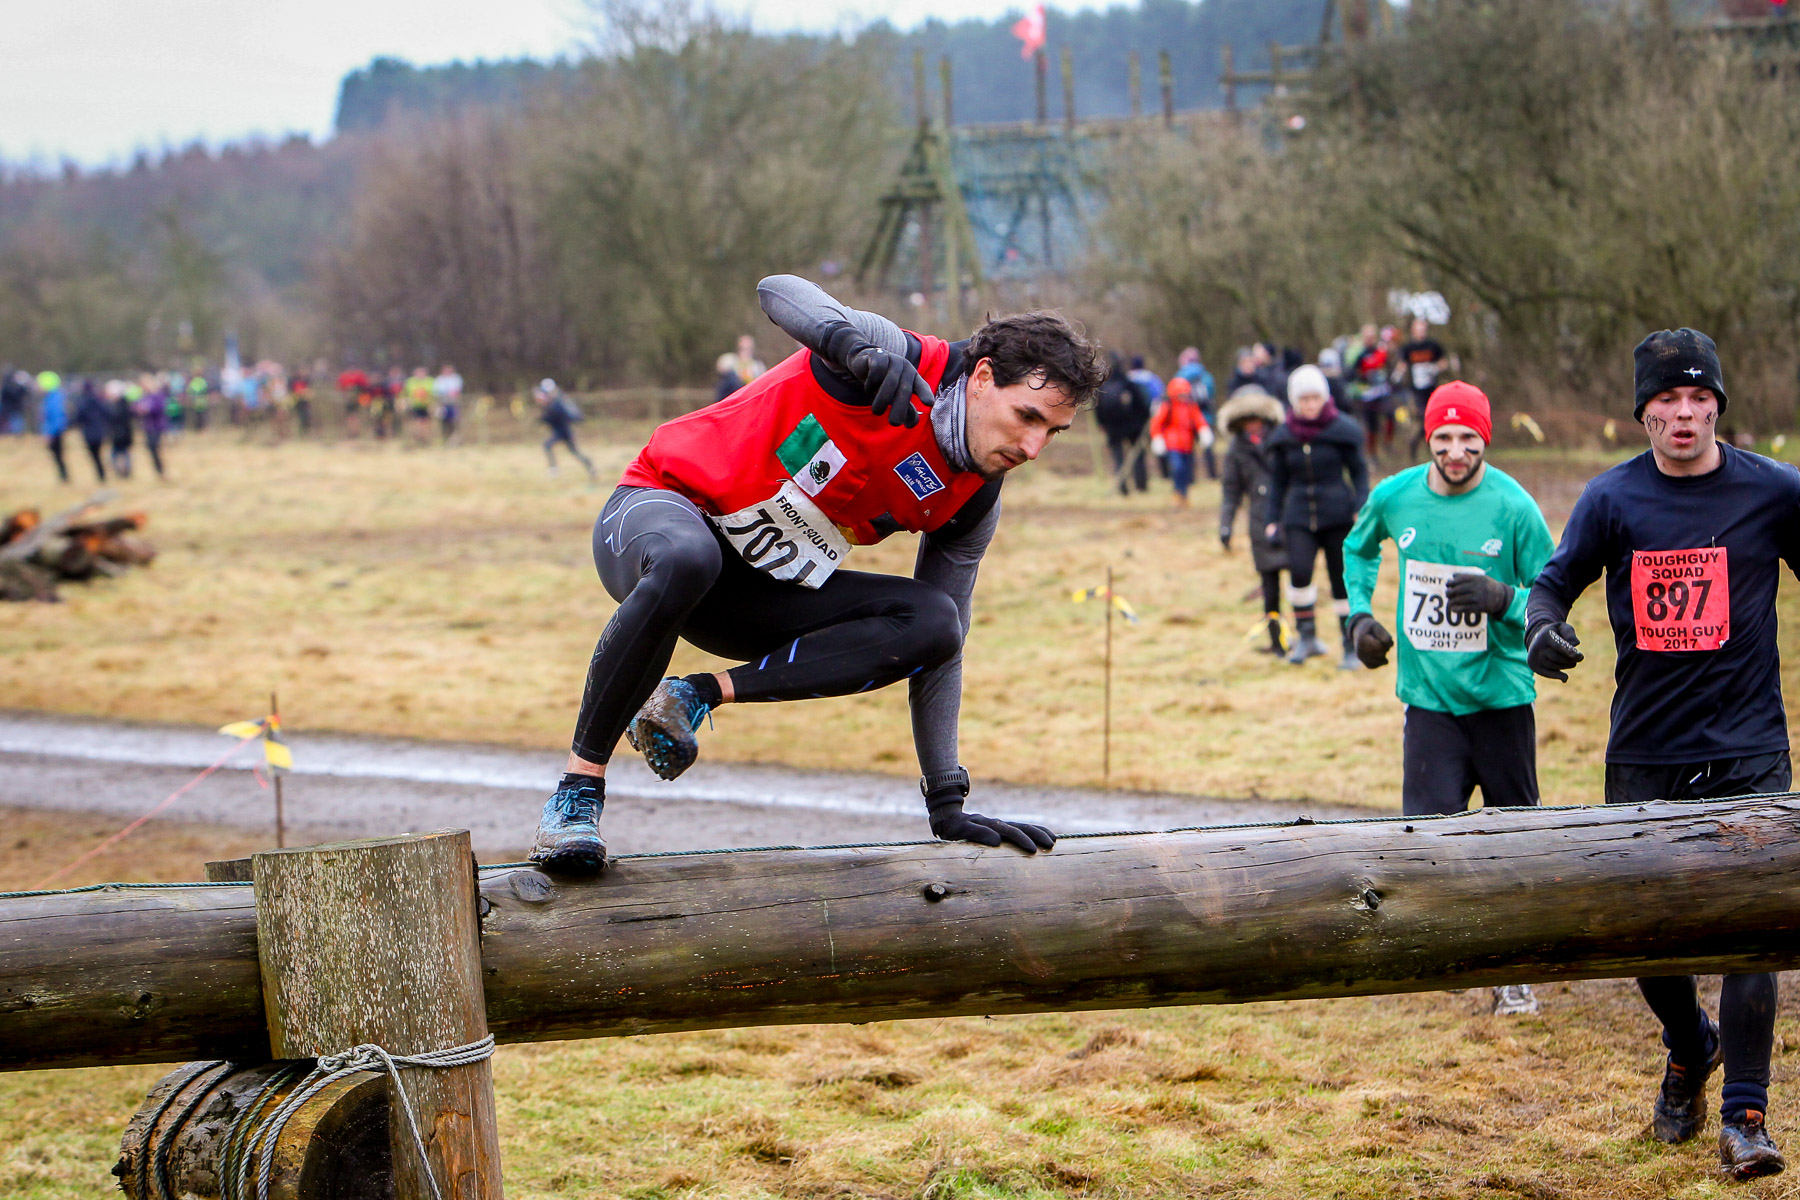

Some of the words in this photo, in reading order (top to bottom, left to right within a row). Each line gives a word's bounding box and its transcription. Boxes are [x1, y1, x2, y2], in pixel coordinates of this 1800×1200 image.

[1646, 414, 1667, 436] 897
[775, 495, 808, 529] FRONT
[803, 527, 838, 561] SQUAD
[1637, 552, 1719, 566] TOUGHGUY
[1409, 573, 1443, 584] FRONT
[1651, 567, 1704, 579] SQUAD
[1646, 579, 1713, 621] 897
[1408, 627, 1450, 639] TOUGH
[1455, 631, 1482, 640] GUY
[1640, 626, 1687, 637] TOUGH
[1692, 625, 1724, 636] GUY
[1430, 640, 1459, 649] 2017
[1663, 638, 1698, 649] 2017
